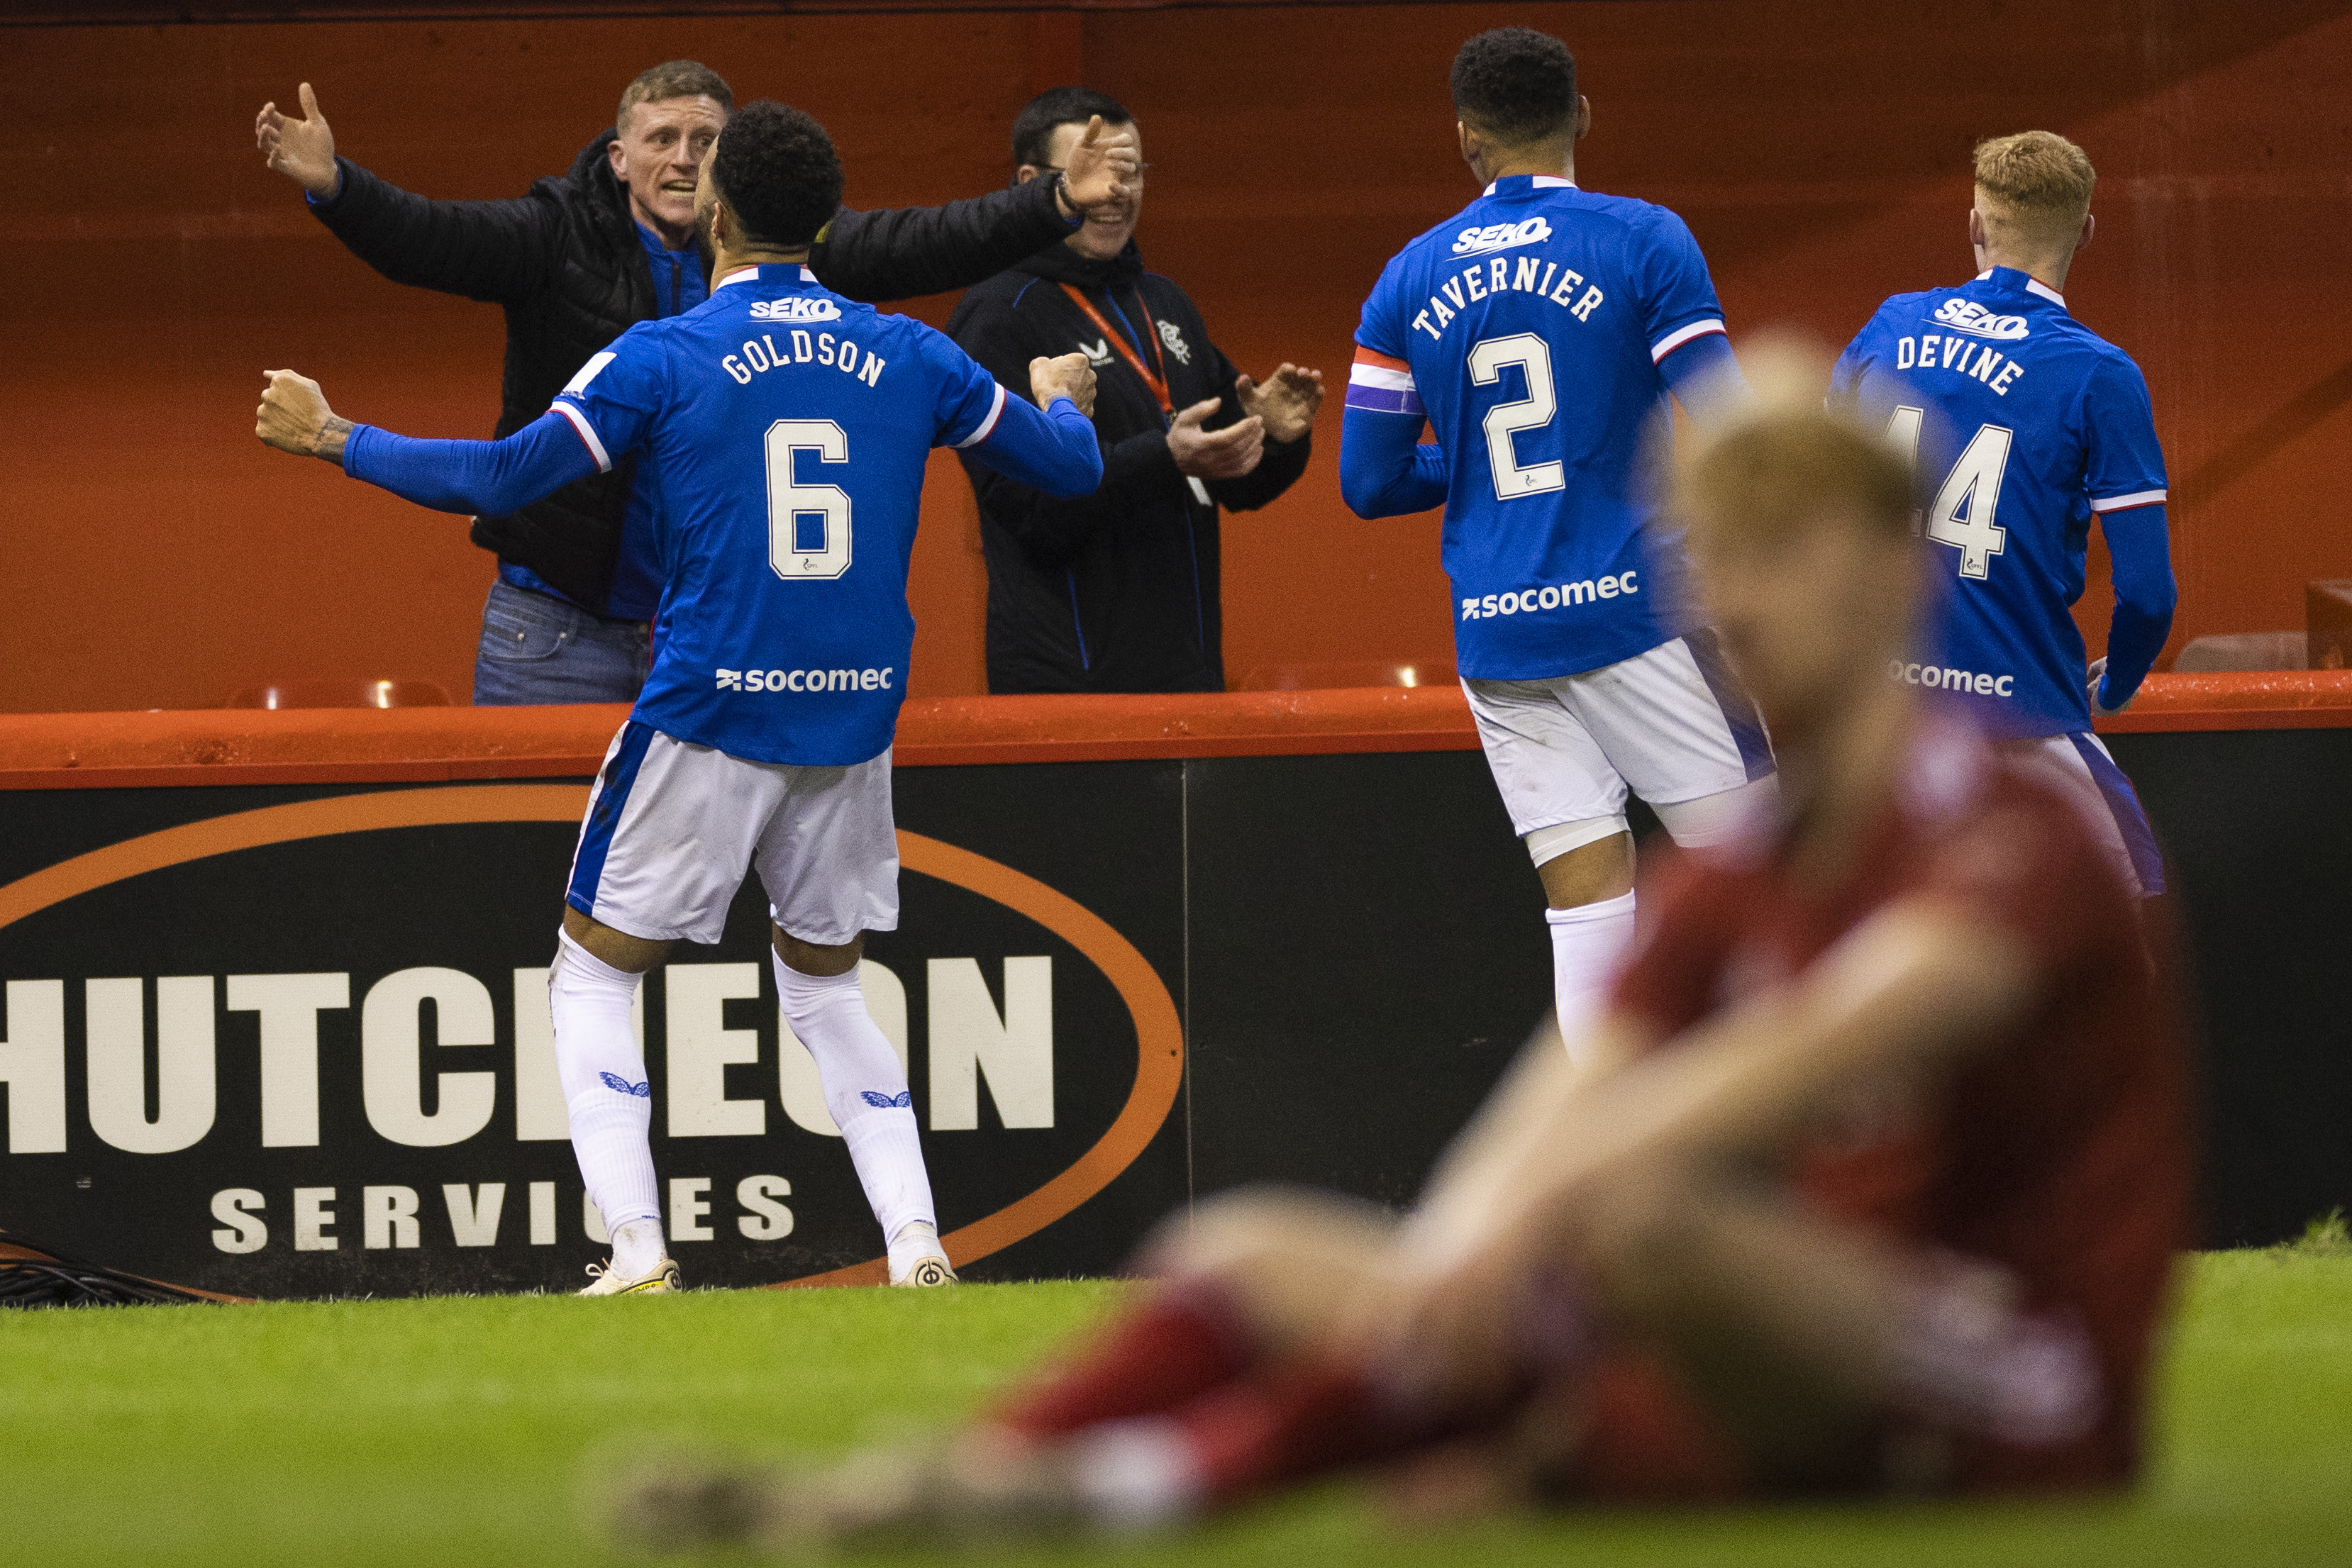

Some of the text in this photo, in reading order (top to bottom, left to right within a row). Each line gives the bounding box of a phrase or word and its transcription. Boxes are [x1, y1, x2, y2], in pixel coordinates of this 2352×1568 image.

[1450, 216, 1553, 262] SEKO
[749, 296, 842, 324] SEKO
[1412, 256, 1604, 340] TAVERNIER
[1931, 298, 2030, 340] SEKO
[722, 330, 886, 388] GOLDSON
[1897, 335, 2024, 396] DEVINE
[1467, 331, 1566, 501] 2
[764, 418, 853, 580] 6
[1482, 571, 1638, 618] socomec
[745, 667, 893, 692] socomec
[1888, 660, 2014, 697] ocomec
